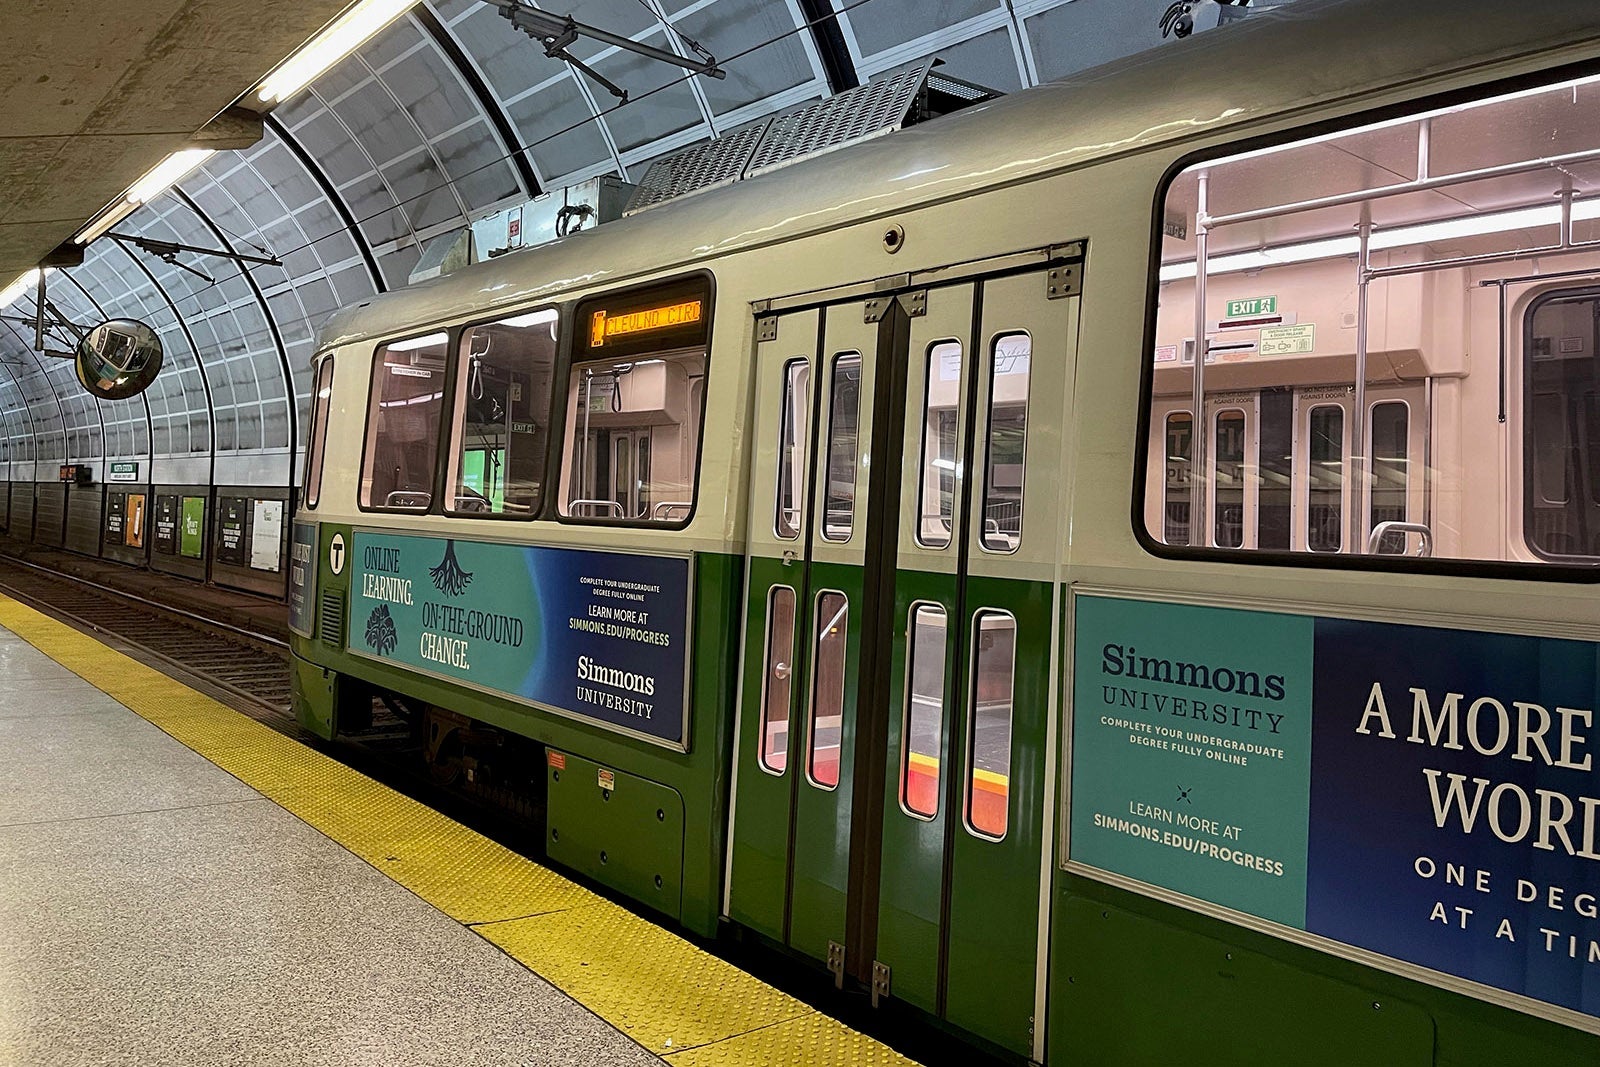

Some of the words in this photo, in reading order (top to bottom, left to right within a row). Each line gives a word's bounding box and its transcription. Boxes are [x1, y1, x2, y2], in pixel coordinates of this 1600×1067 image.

[1232, 300, 1258, 315] EXIT
[514, 423, 526, 432] EXIT
[333, 543, 342, 569] T
[364, 546, 400, 573] ONLINE
[363, 573, 413, 606] LEARNING.
[580, 577, 604, 587] COMPLETE
[604, 580, 617, 588] YOUR
[617, 581, 660, 593] UNDERGRADUATE
[593, 588, 611, 597] DEGREE
[611, 591, 626, 600] FULLY
[626, 592, 645, 602] ONLINE
[588, 604, 612, 619] LEARN
[613, 609, 637, 624] MORE
[638, 612, 649, 625] AT
[569, 617, 670, 647] SIMMONS.EDU/PROGRESS
[420, 632, 470, 670] CHANGE.
[577, 655, 655, 696] Simmons
[1102, 643, 1286, 701] Simmons
[576, 686, 653, 720] UNIVERSITY
[1102, 685, 1285, 734] UNIVERSITY
[1100, 716, 1152, 734] COMPLETE
[1155, 726, 1183, 740] YOUR
[1186, 732, 1284, 759] UNDERGRADUATE
[1355, 682, 1396, 739] A
[1406, 687, 1593, 772] MORE
[1130, 735, 1168, 750] DEGREE
[1171, 743, 1203, 757] FULLY
[1205, 750, 1248, 766] ONLINE
[1129, 801, 1173, 824] LEARN
[1176, 813, 1220, 836] MORE
[1223, 825, 1243, 841] AT
[1094, 813, 1284, 877] SIMMONS.EDU/PROGRESS
[1414, 856, 1491, 893] ONE
[1517, 879, 1597, 918] DEG
[1430, 901, 1473, 930] AT
[1495, 918, 1515, 942] A
